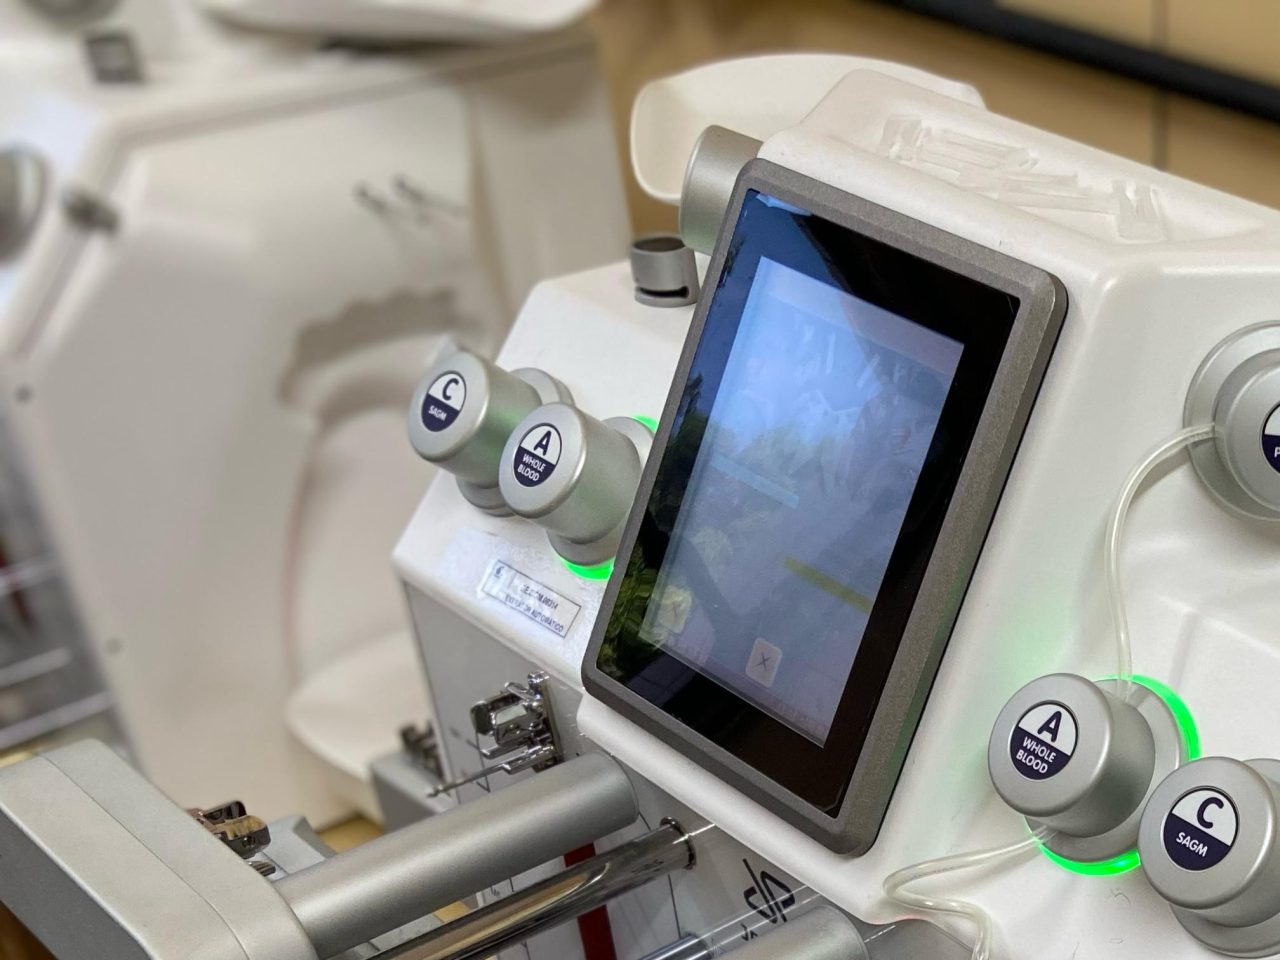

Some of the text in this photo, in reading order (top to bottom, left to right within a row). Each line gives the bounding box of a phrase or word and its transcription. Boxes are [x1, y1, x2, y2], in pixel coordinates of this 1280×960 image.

[442, 377, 459, 401] C
[428, 405, 447, 421] SAGM
[533, 430, 552, 456] A
[517, 464, 540, 481] BLOOD
[522, 453, 546, 473] WHOLE
[1037, 710, 1063, 743] A
[1016, 749, 1048, 774] BLOOD
[1022, 737, 1056, 763] WHOLE
[1196, 797, 1224, 829] C
[1175, 831, 1209, 858] SAGM
